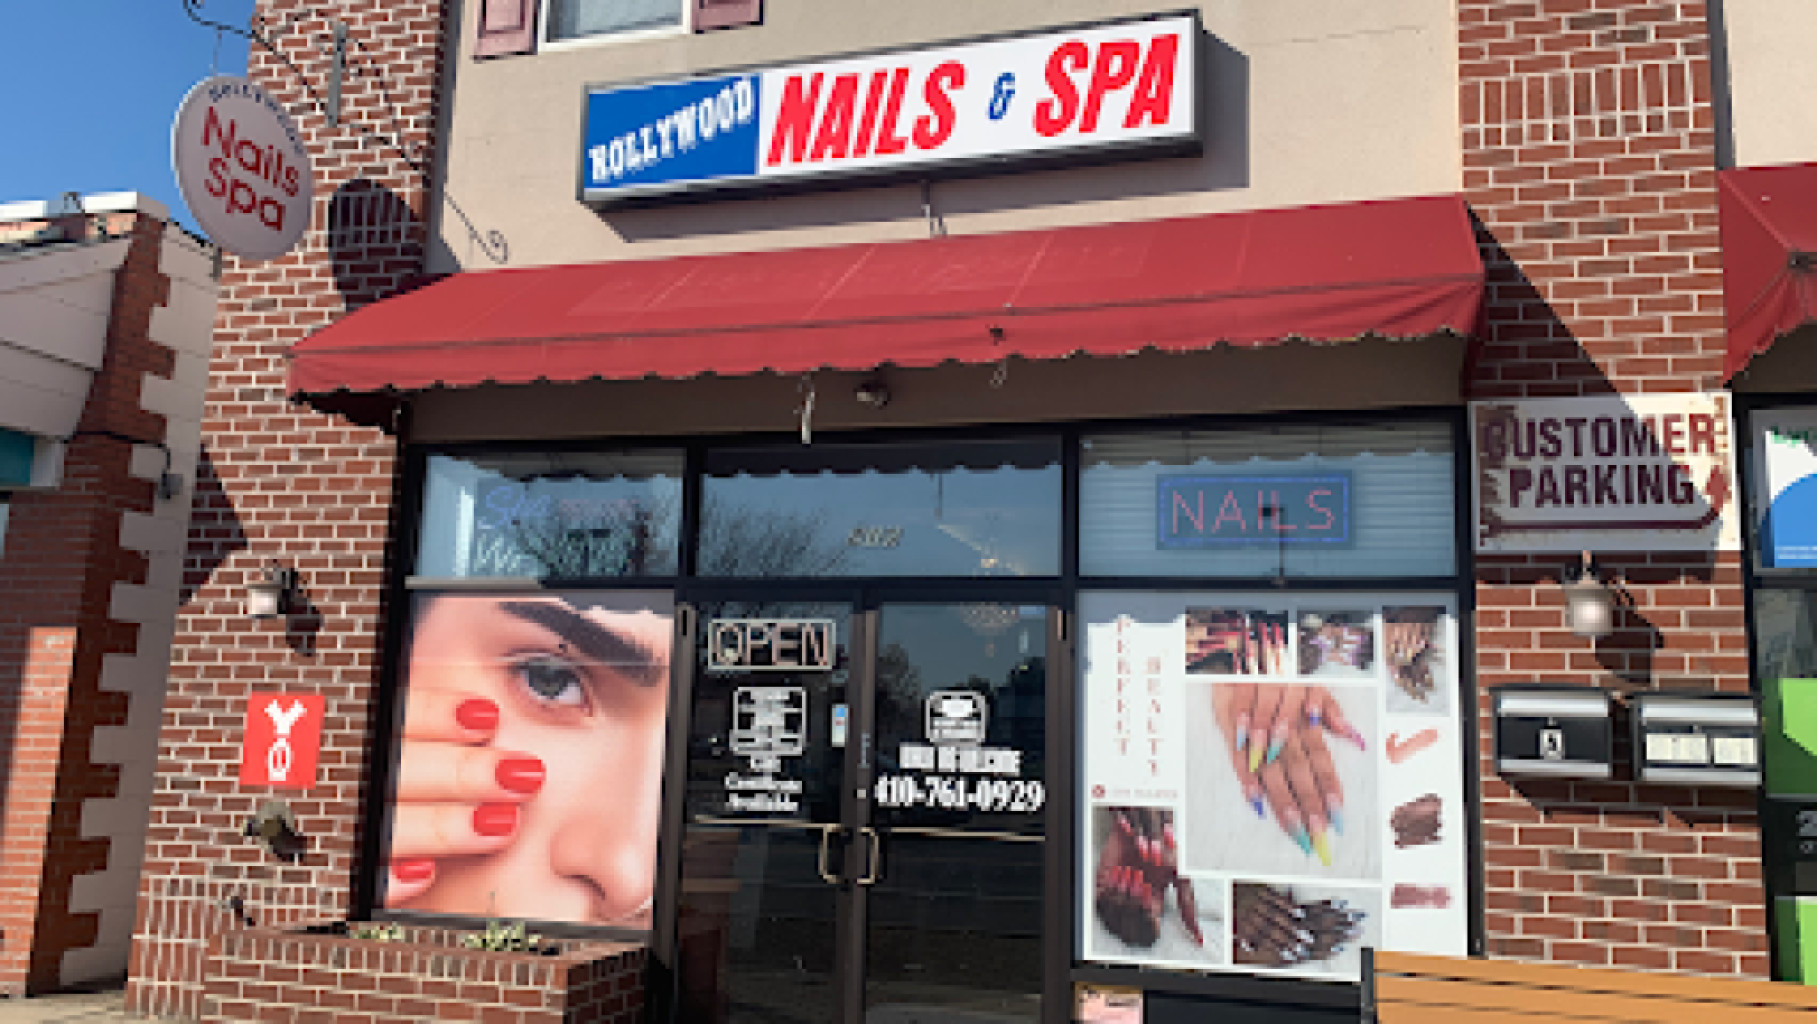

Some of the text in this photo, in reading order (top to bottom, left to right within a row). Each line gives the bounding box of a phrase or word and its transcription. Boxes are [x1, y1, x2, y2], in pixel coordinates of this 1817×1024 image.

[766, 34, 1180, 168] NAILS & SPA
[201, 106, 298, 198] Nails
[589, 80, 754, 184] HOLLYWOOD
[1508, 464, 1695, 508] PARKING
[1172, 488, 1336, 535] NAILS
[716, 622, 828, 667] OPEN
[874, 773, 1046, 813] 410-761-0929
